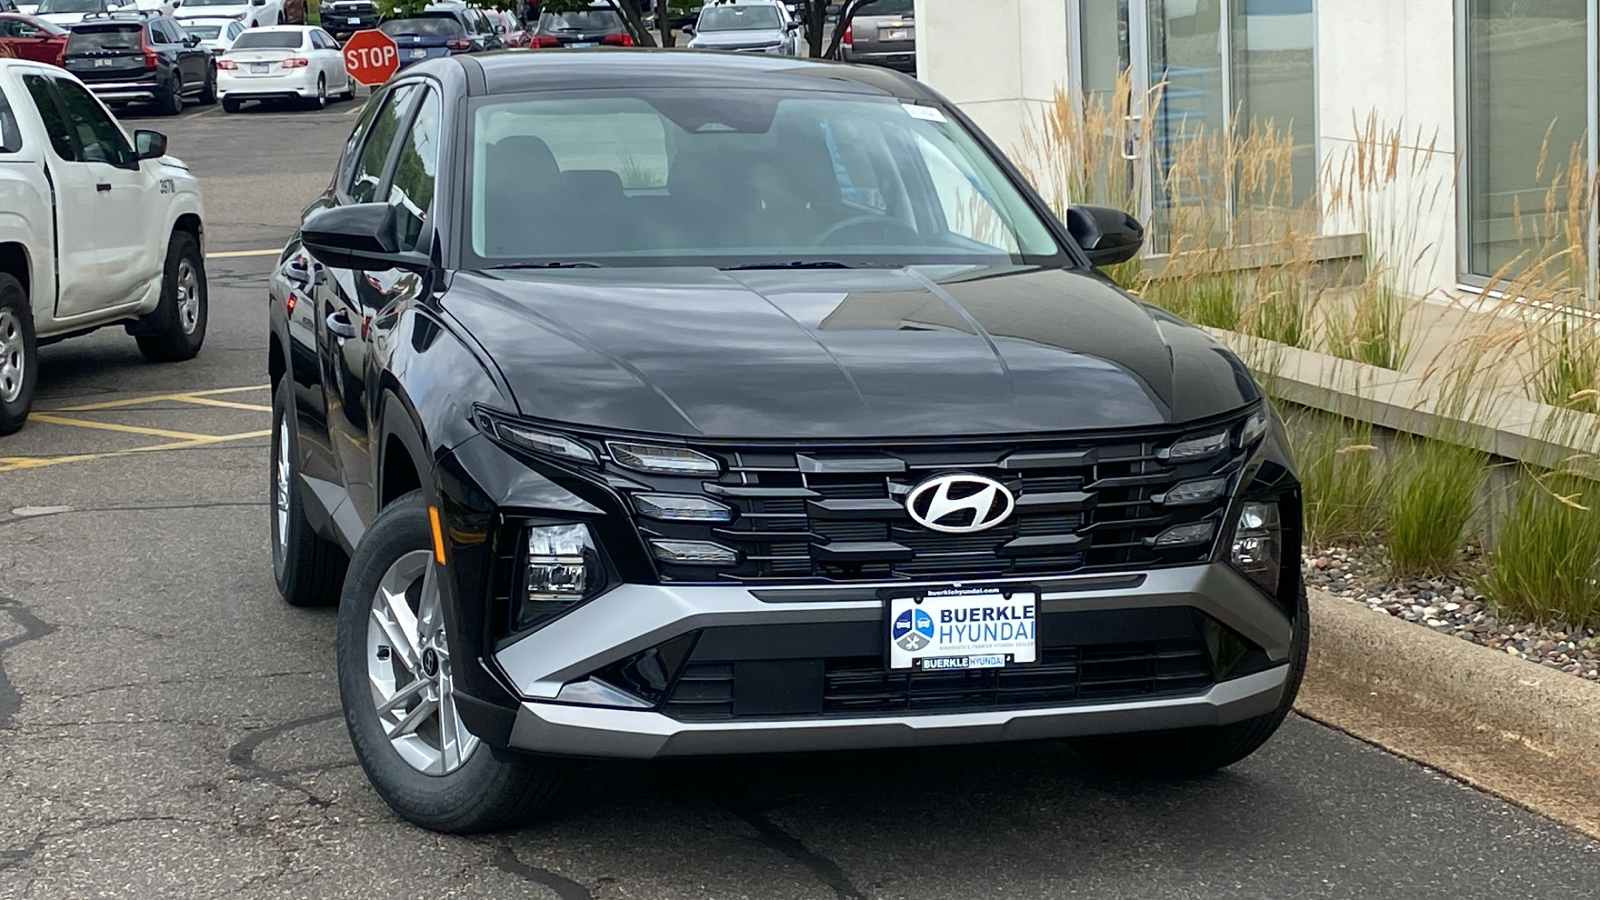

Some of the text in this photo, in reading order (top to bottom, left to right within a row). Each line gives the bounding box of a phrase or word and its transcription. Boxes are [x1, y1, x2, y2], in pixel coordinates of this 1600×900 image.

[347, 45, 395, 70] STOP
[927, 588, 1000, 597] buerklehyundai.com
[940, 605, 1034, 623] BUERKLE
[940, 621, 1035, 644] HYUNDAI
[923, 656, 1003, 669] BUERKLE HYUNDAI
